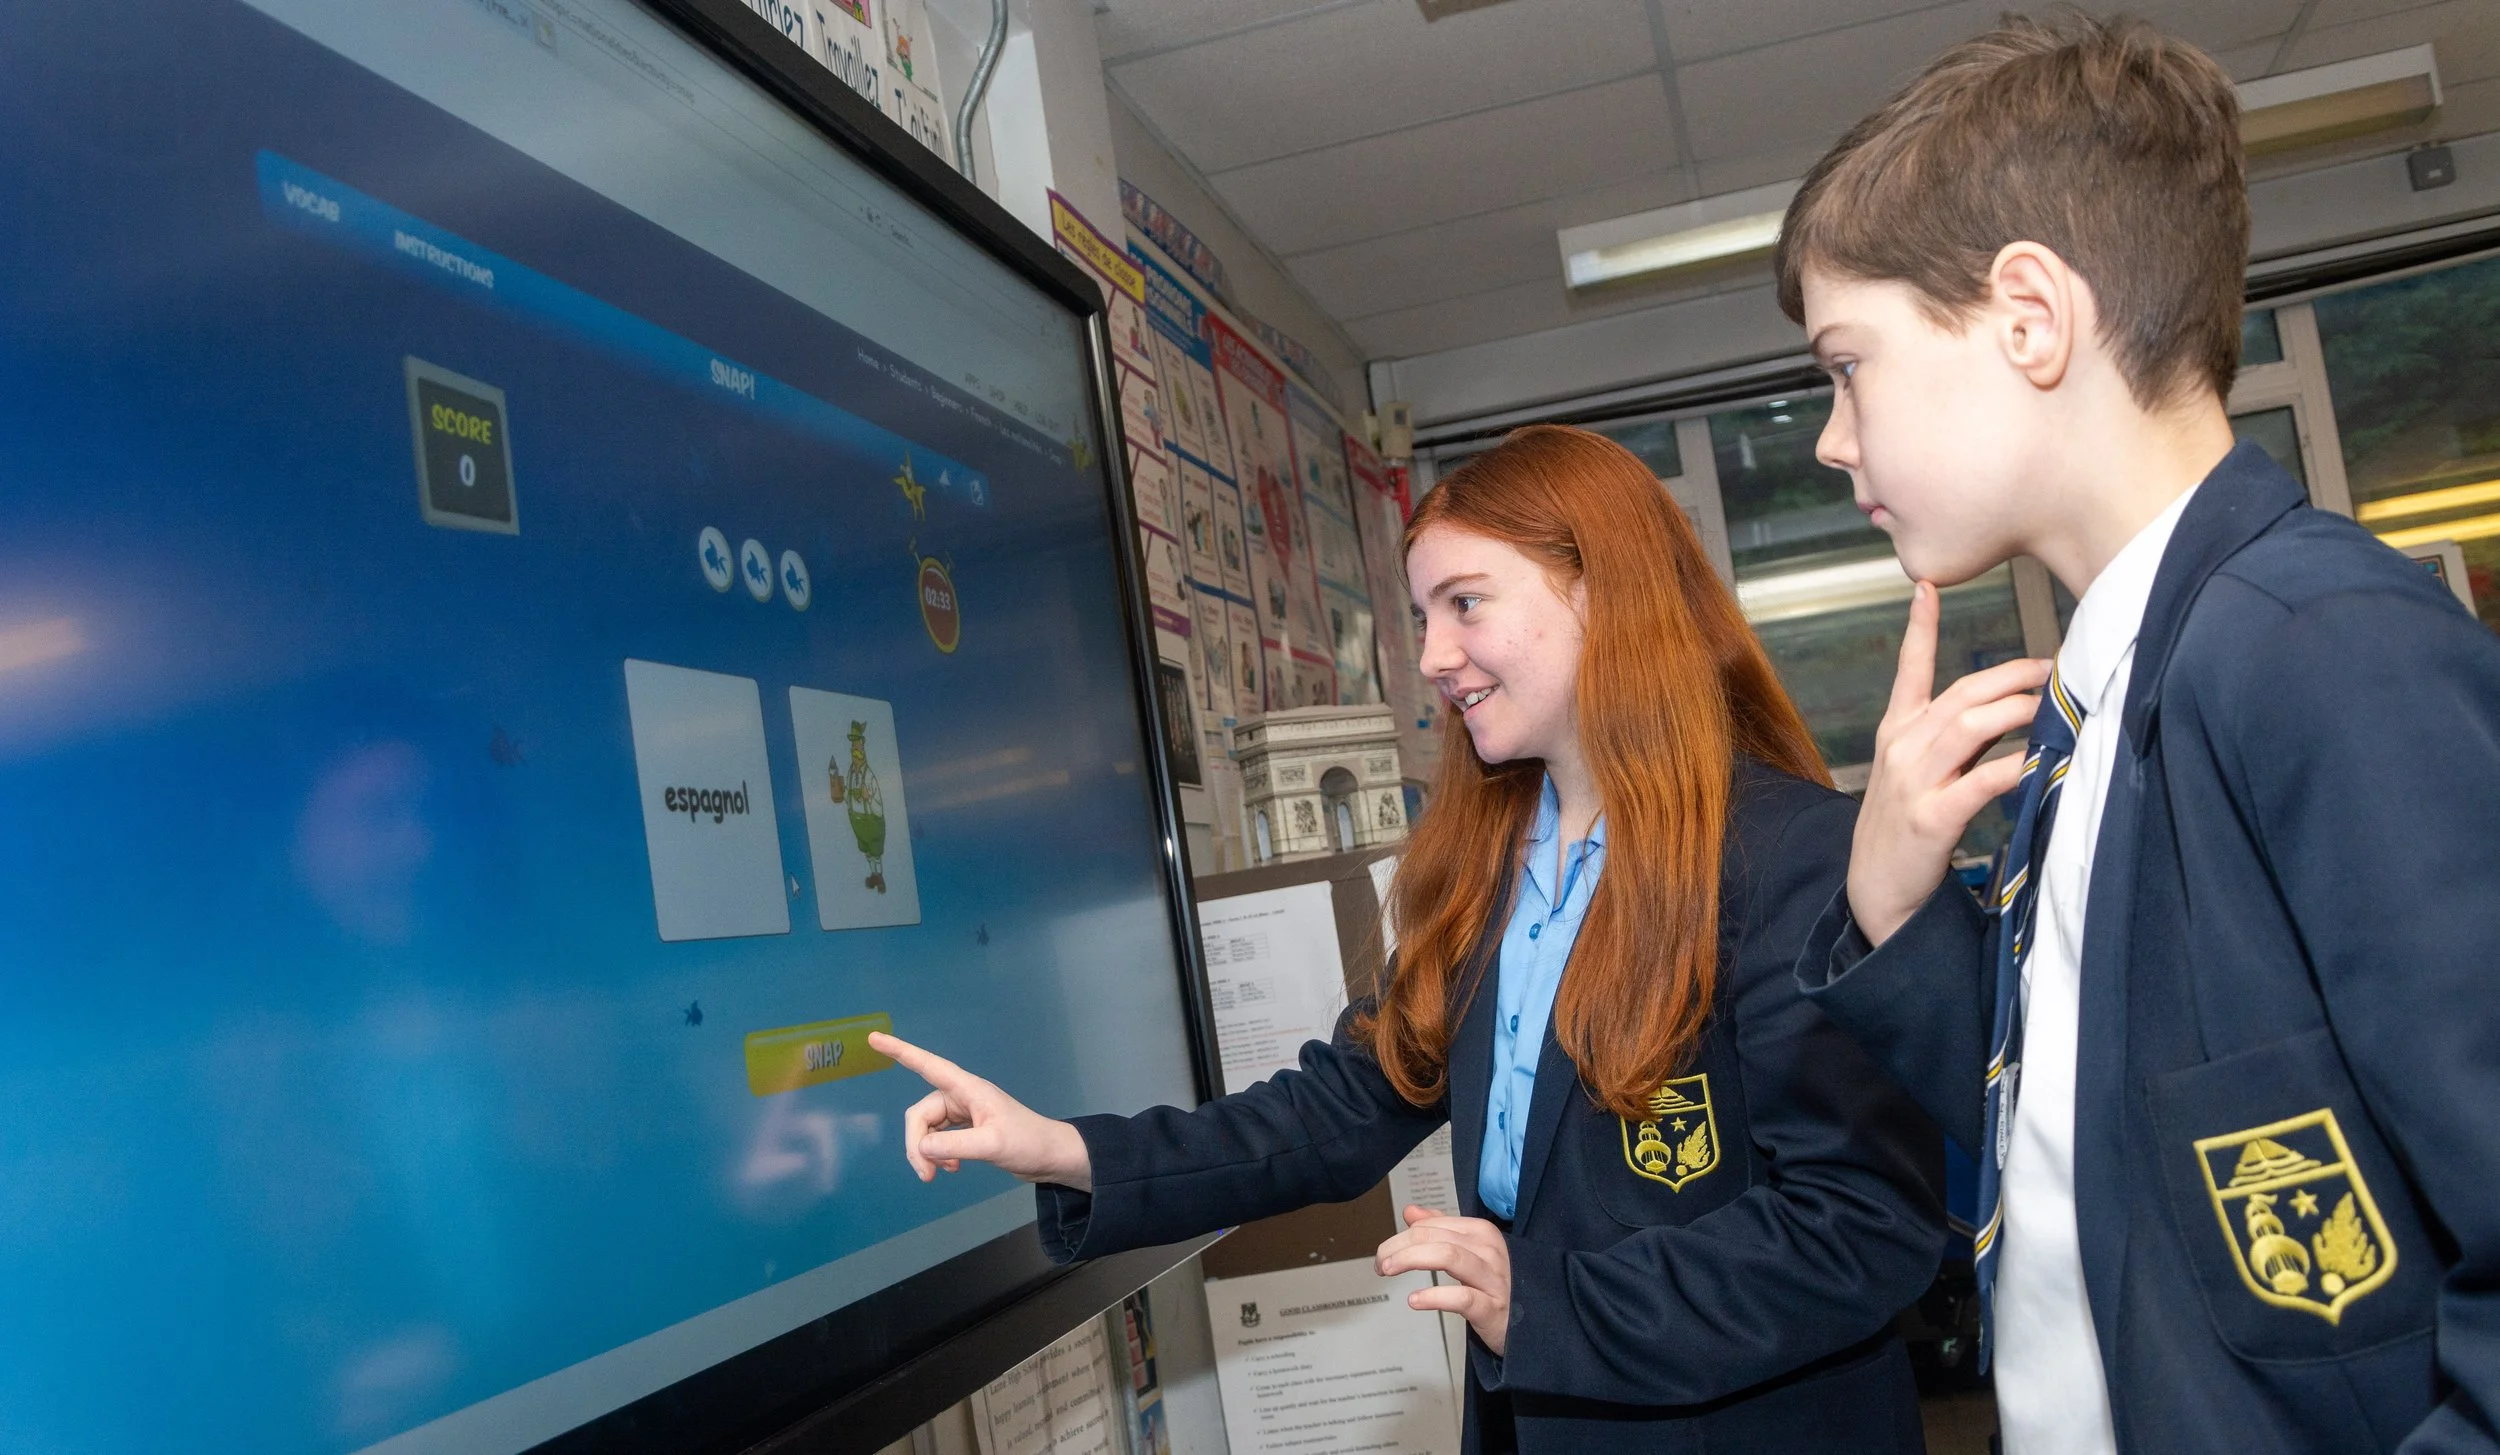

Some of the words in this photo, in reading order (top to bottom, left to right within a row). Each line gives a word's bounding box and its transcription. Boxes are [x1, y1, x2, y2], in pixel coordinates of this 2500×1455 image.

[750, 0, 804, 50] rlez
[282, 182, 340, 222] VOCAB
[394, 230, 494, 288] INSTRUCTIONS
[857, 346, 880, 371] Home
[710, 357, 756, 401] SNAP!
[431, 404, 492, 445] SCORE
[459, 454, 476, 487] 0
[925, 585, 951, 611] 02:33
[664, 780, 750, 824] espagnol
[804, 1040, 844, 1072] SNAP
